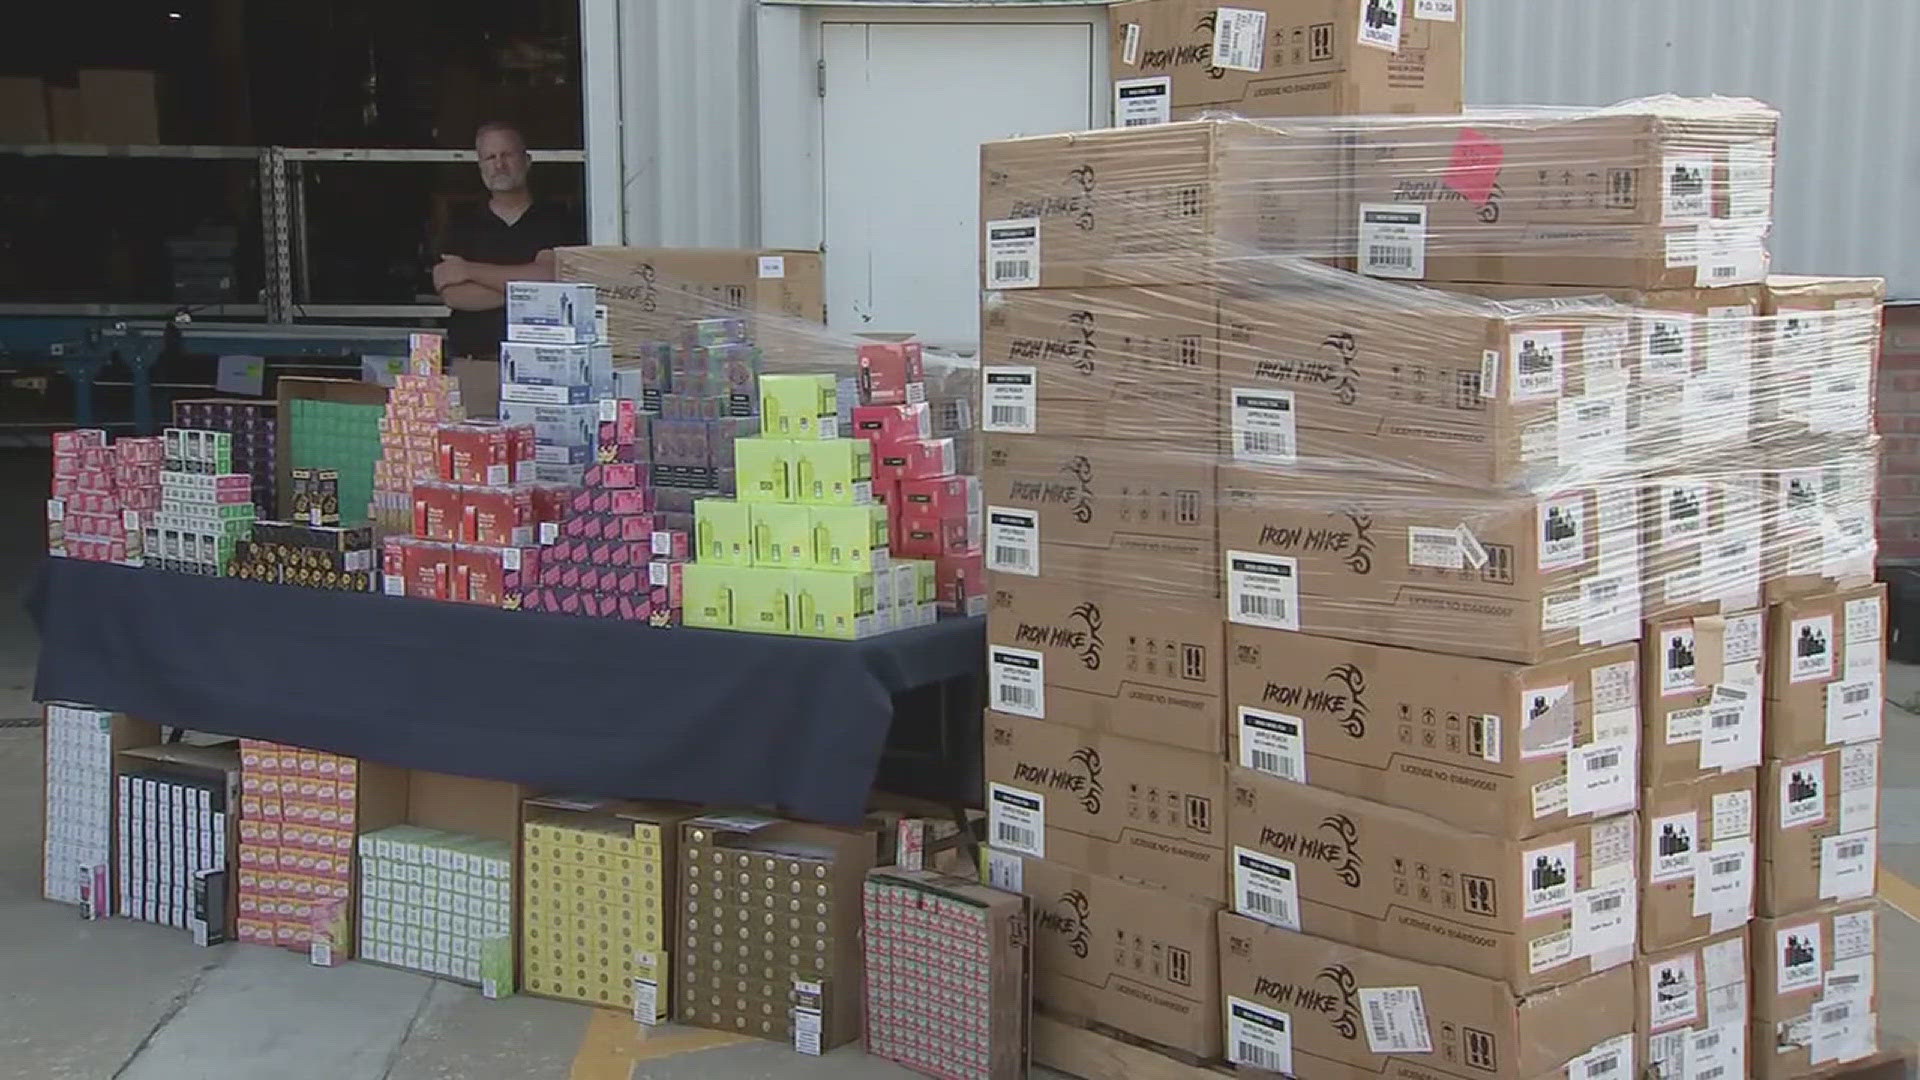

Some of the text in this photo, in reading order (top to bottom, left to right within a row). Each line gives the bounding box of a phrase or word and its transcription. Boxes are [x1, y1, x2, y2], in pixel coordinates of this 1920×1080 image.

[1140, 43, 1212, 70] IRON MIKE
[1009, 339, 1079, 360] IRON MIKE
[1009, 479, 1078, 503] IRON MIKE
[1259, 524, 1353, 552] IRON MIKE
[1015, 623, 1089, 649] IRON MIKE
[1262, 681, 1349, 713] IRON MIKE
[1014, 763, 1088, 792] IRON MIKE
[1259, 826, 1343, 863] IRON MIKE
[1040, 909, 1076, 933] MIKE
[1254, 974, 1340, 1014] IRON MIKE
